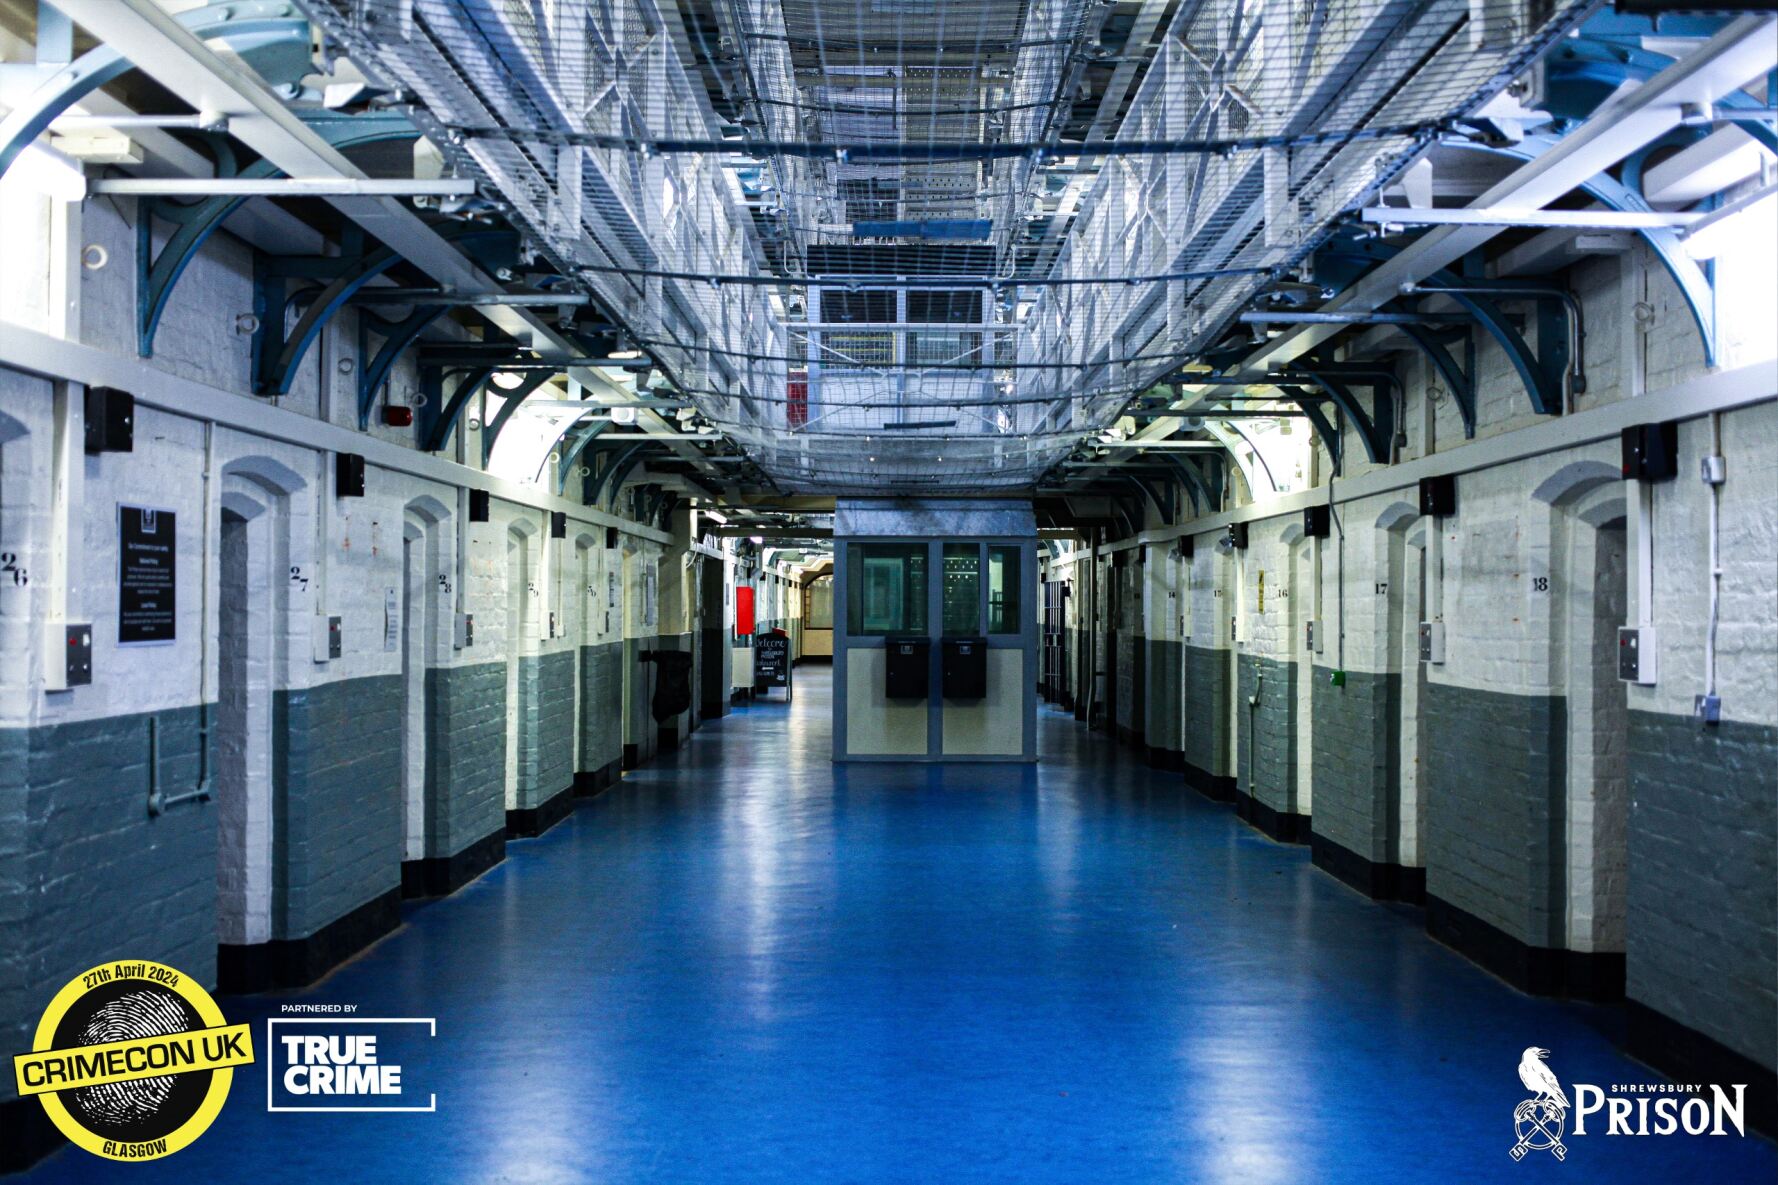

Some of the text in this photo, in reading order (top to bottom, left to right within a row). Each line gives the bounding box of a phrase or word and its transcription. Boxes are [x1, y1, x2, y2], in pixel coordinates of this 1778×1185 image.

[1, 552, 28, 587] 26
[290, 566, 309, 592] 27
[439, 574, 452, 593] 28
[1532, 576, 1548, 592] 18
[1277, 589, 1288, 598] 16
[1375, 583, 1388, 595] 17
